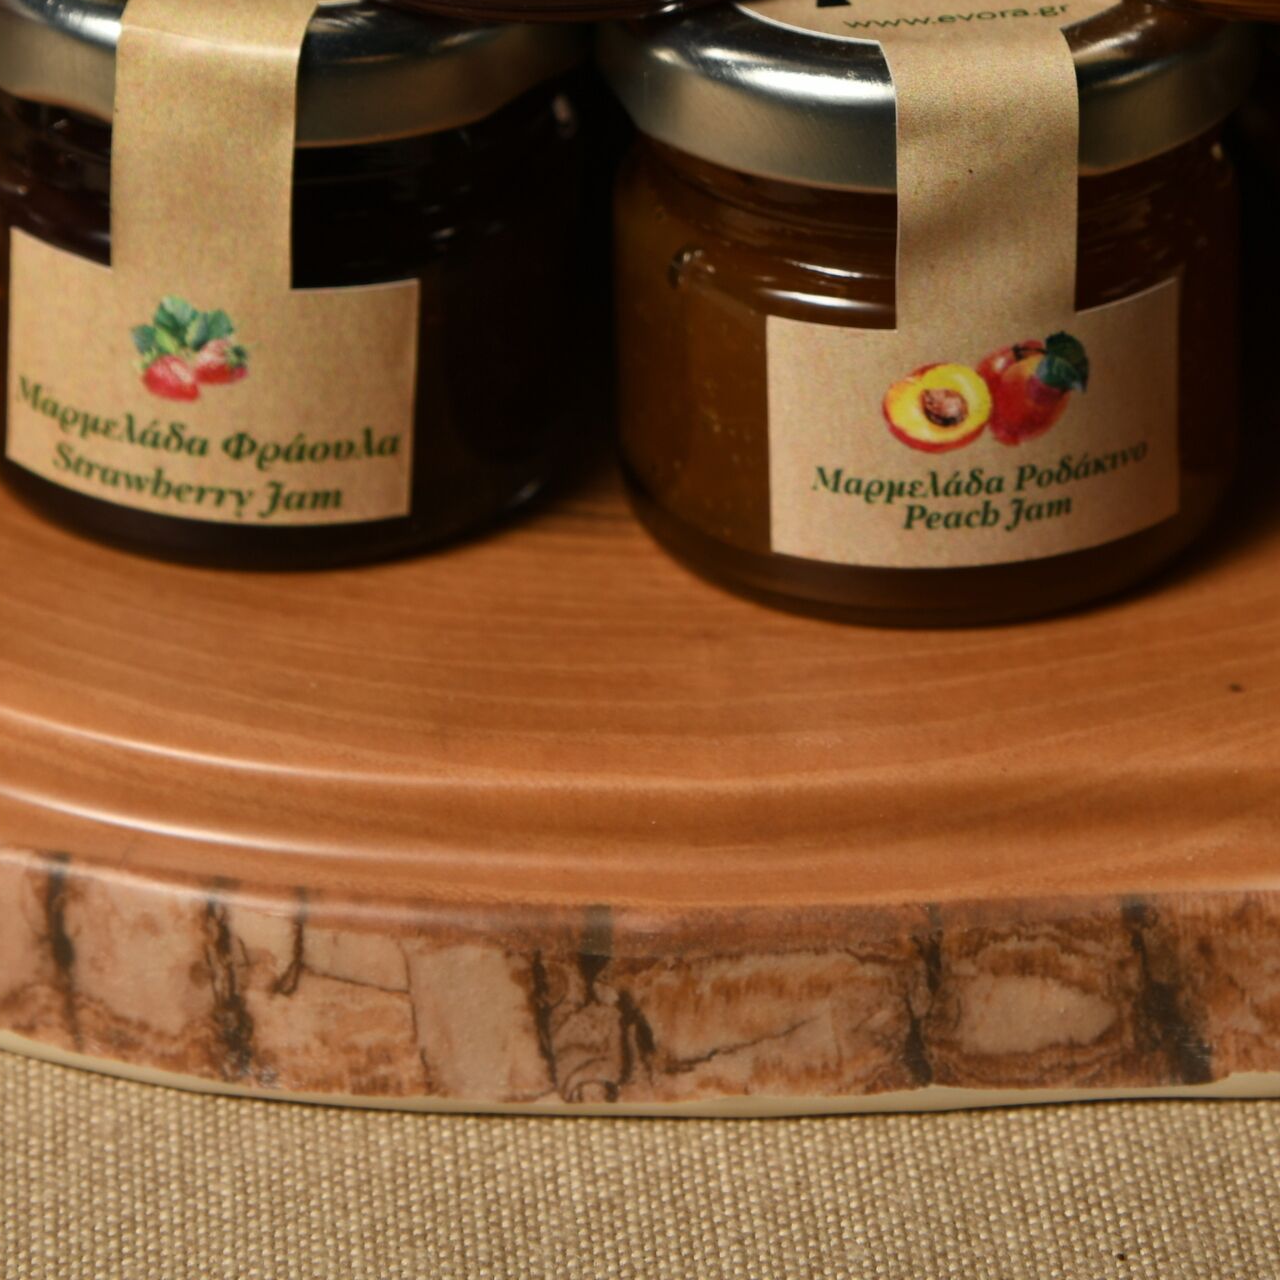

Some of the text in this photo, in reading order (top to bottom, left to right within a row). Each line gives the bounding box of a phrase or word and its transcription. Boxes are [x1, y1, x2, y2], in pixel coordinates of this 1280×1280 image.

[843, 3, 1070, 29] www.evora.gr
[15, 374, 402, 472] Μαρμελάδα Φράουλα
[51, 441, 344, 519] Strawberry Jam
[811, 440, 1149, 505] Μαρμελάδα Ροδάκινο
[902, 496, 1073, 532] Peach Jam
